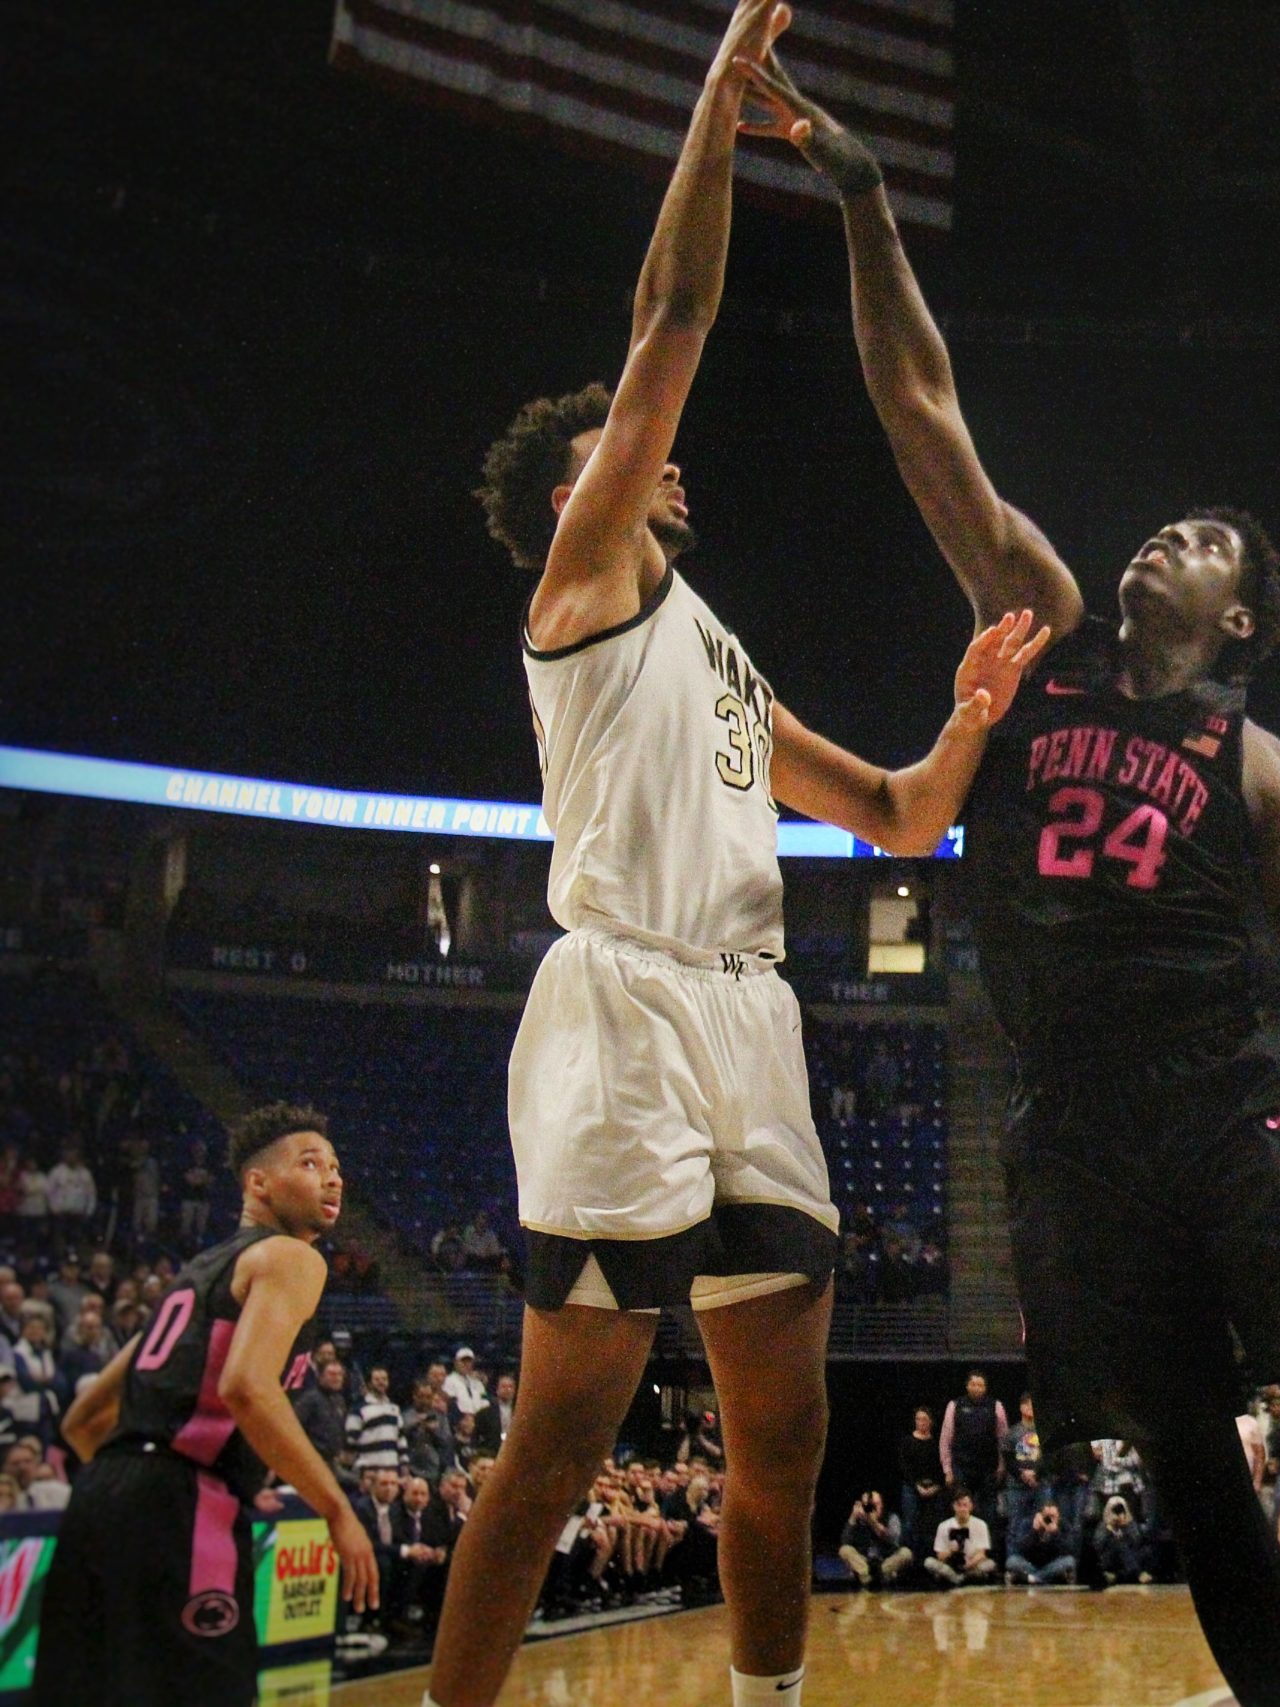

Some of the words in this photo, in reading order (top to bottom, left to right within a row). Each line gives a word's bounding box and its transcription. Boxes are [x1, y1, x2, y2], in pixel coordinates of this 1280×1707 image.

[166, 773, 281, 814] CHANNEL
[292, 790, 356, 823] YOUR
[363, 798, 446, 829] INNER
[451, 804, 531, 835] POINT
[1026, 726, 1119, 791] PENN
[1118, 736, 1209, 837] STATE
[1037, 787, 1168, 889] 24
[386, 962, 485, 987] MOTHER
[136, 1288, 196, 1371] 0
